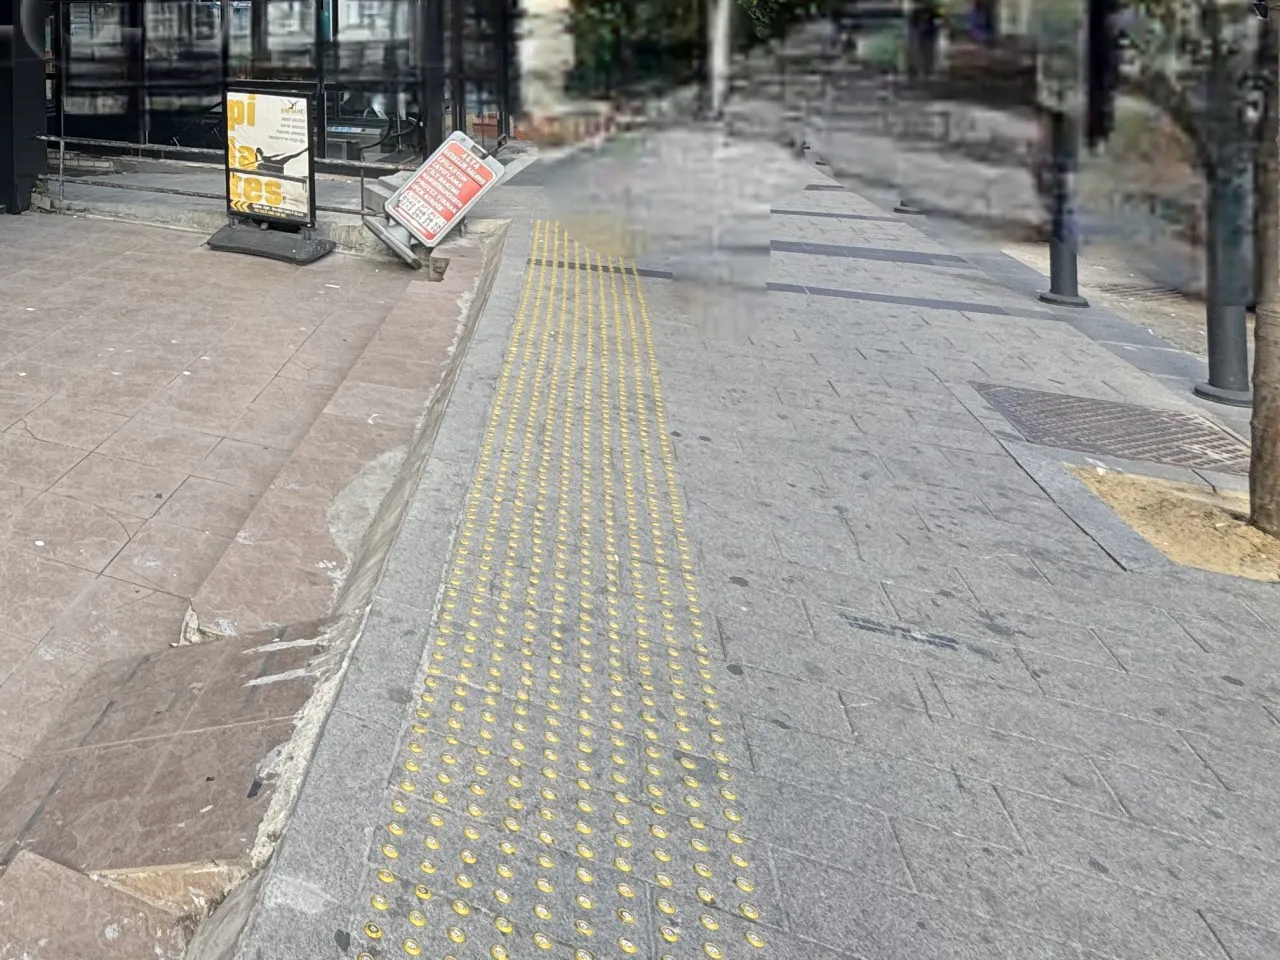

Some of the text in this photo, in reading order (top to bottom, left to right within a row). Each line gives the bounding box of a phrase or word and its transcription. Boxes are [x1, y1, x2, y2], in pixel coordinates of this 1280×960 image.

[228, 93, 256, 131] pi
[228, 136, 257, 170] la
[229, 171, 282, 206] tes
